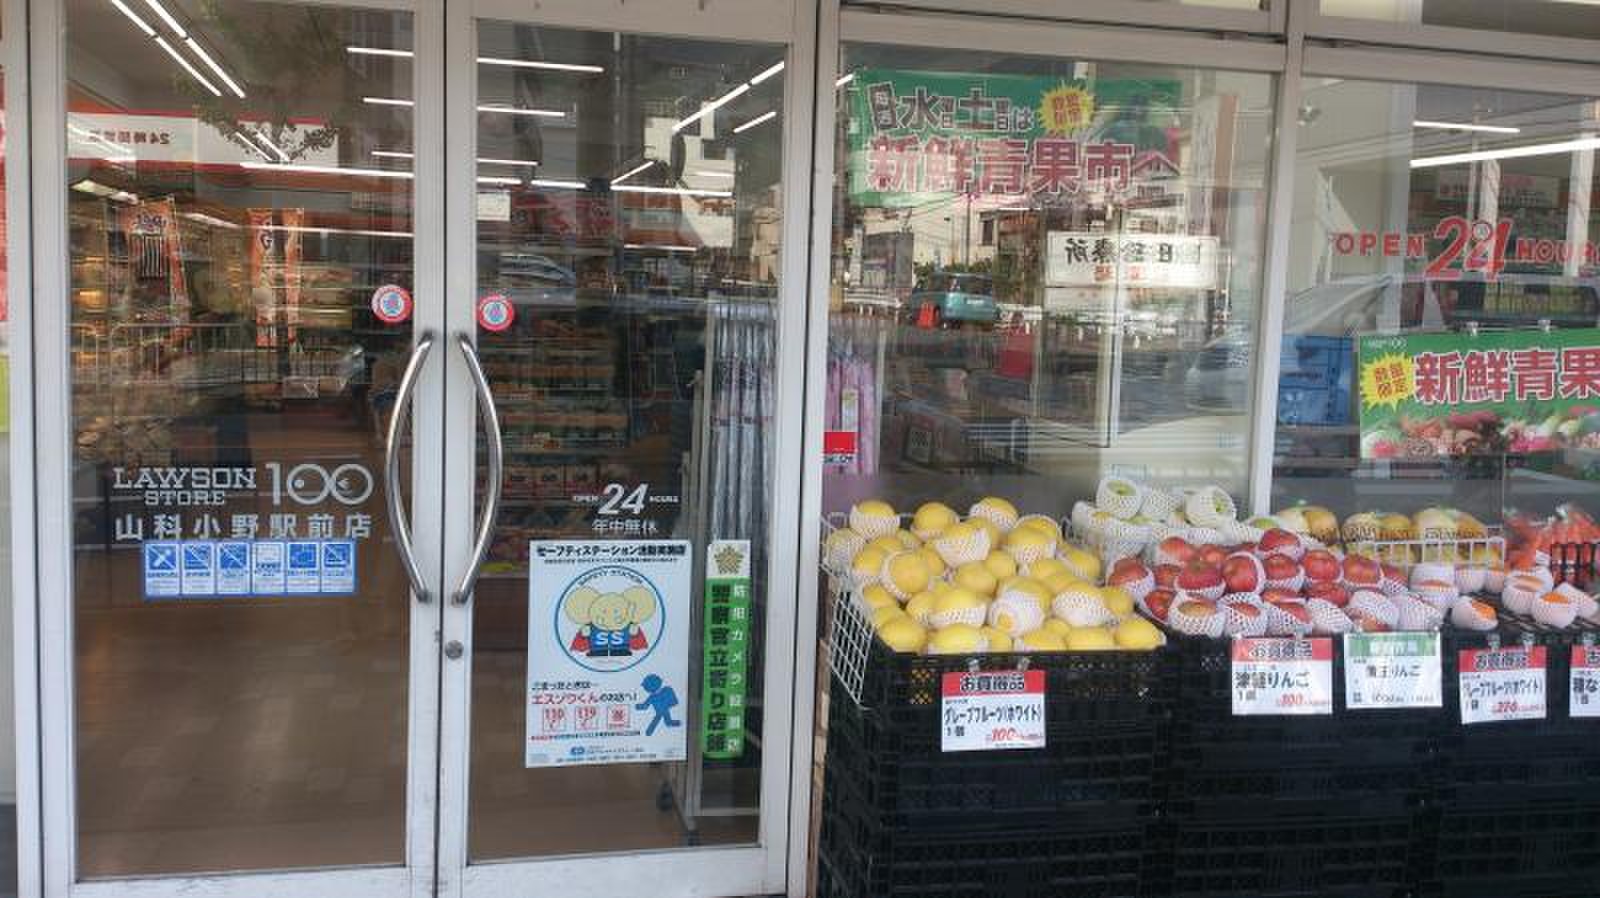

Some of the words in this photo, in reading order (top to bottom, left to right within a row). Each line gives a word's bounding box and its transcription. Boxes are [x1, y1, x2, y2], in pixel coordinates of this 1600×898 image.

[1335, 232, 1424, 257] OPEN
[1426, 217, 1512, 282] 24
[1516, 238, 1600, 263] HOUR
[113, 467, 257, 489] LAWSON
[265, 463, 374, 506] 100
[144, 490, 226, 506] STORE
[597, 483, 649, 515] 24
[115, 513, 373, 541] 山科小野駅前店
[591, 518, 659, 534] 年中無休
